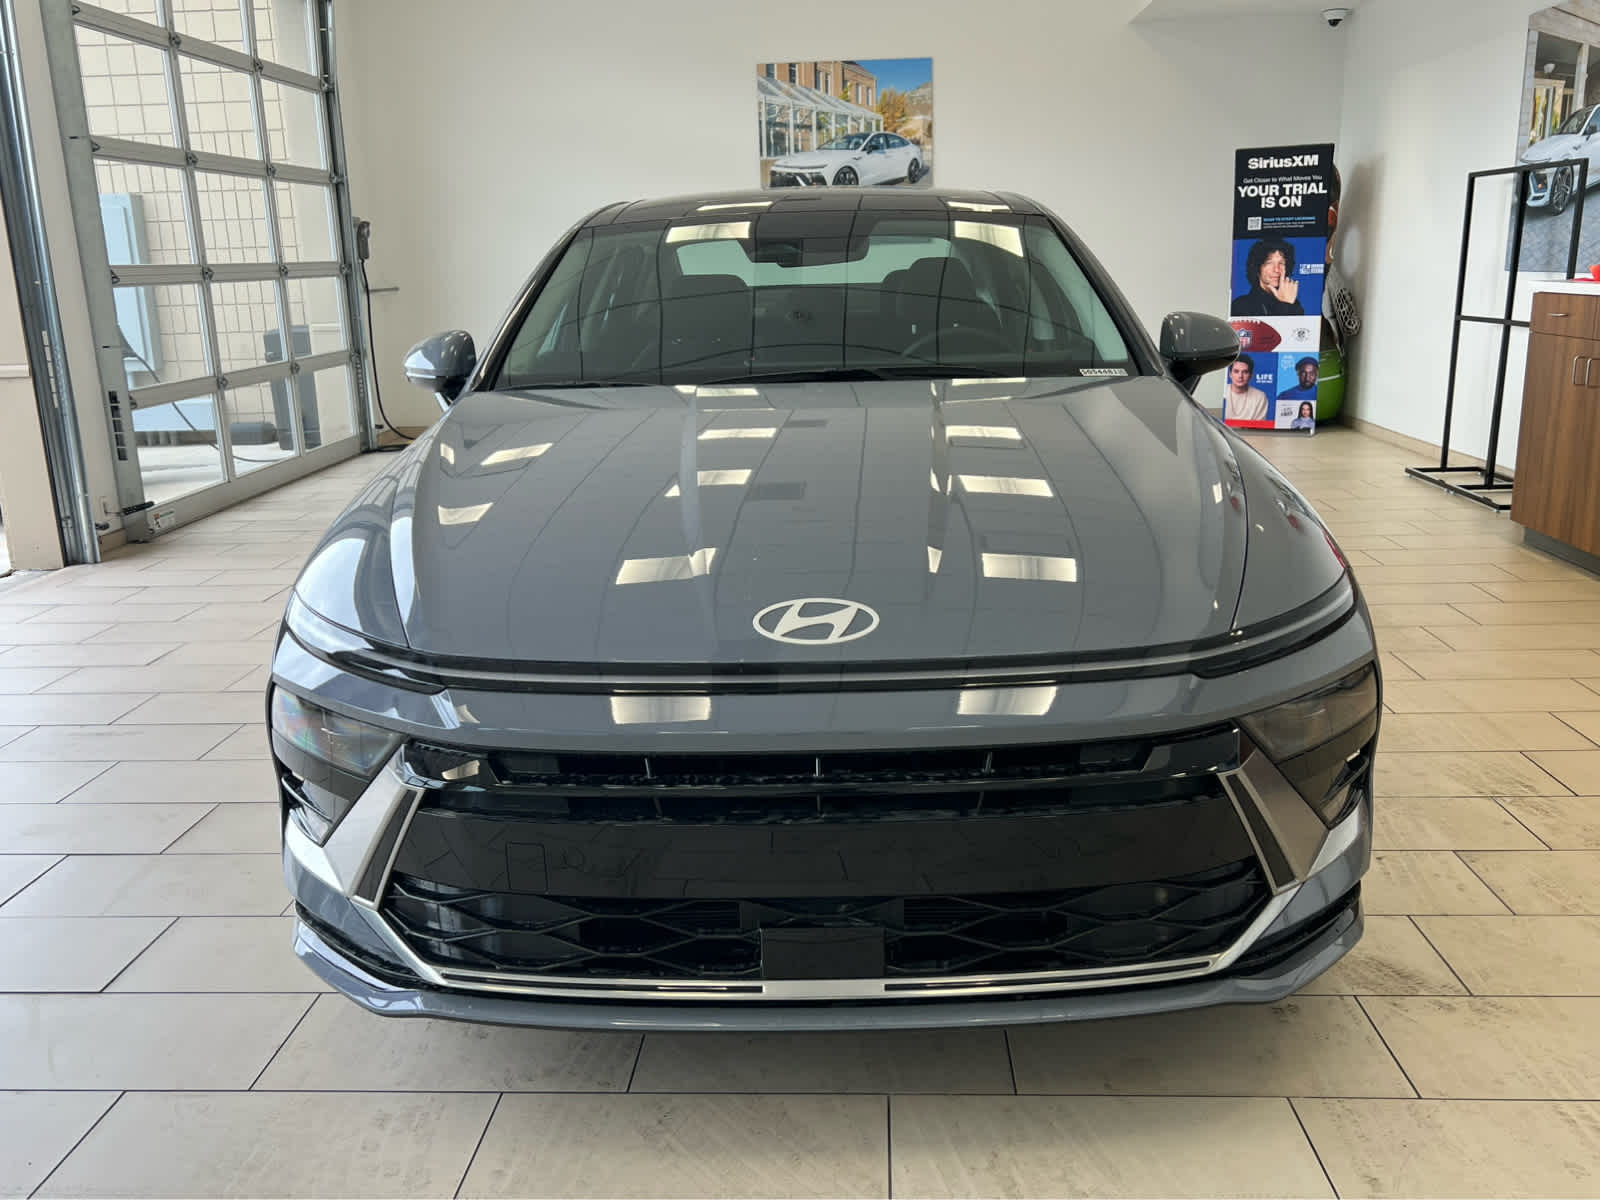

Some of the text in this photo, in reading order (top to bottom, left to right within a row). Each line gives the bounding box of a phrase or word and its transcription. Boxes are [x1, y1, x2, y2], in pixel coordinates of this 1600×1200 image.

[1248, 154, 1319, 169] SiriusXM
[1238, 182, 1328, 198] YOUR TRIAL
[1261, 196, 1302, 209] IS ON
